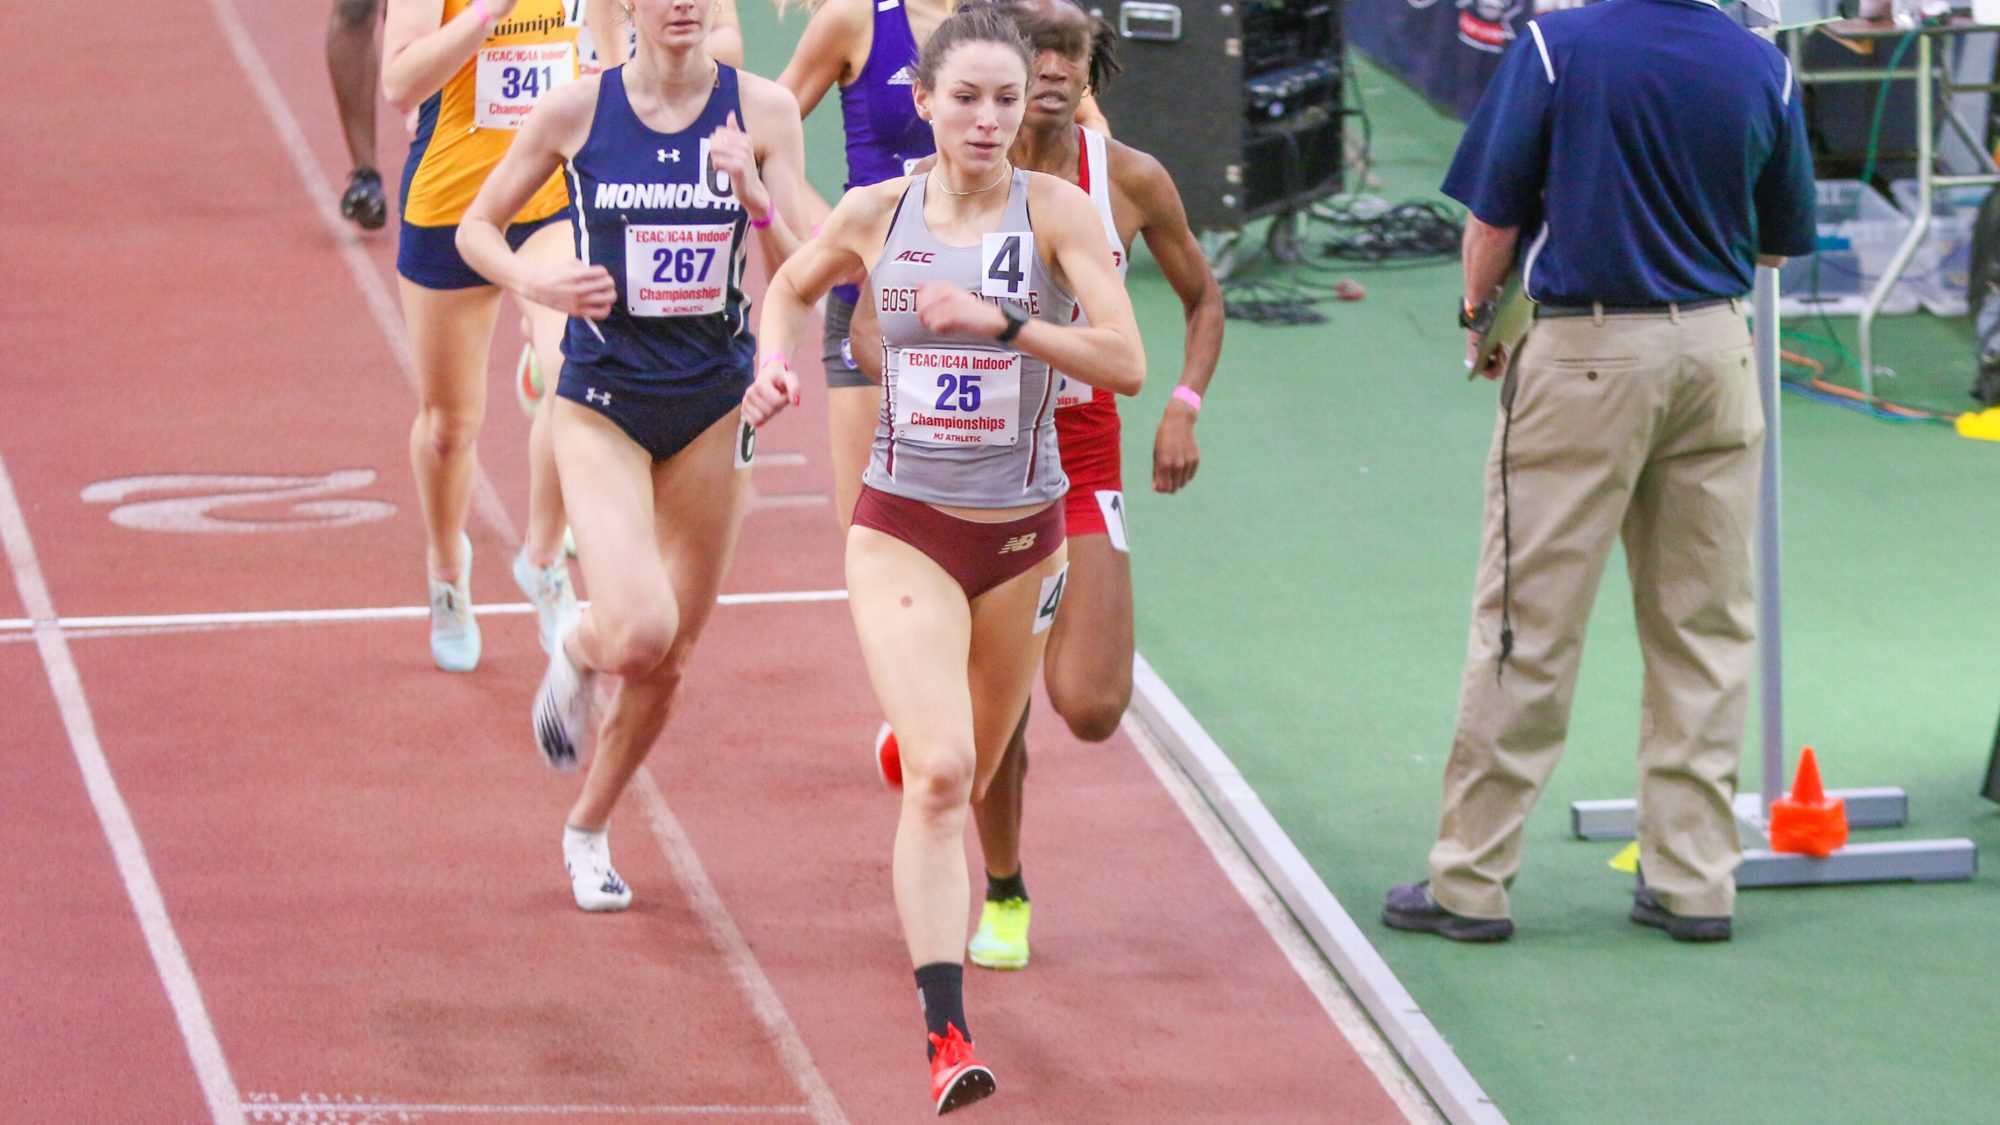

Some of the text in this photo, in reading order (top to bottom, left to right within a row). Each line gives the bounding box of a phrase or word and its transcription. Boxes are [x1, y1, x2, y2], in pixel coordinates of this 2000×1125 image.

[488, 9, 565, 41] uinnipi
[502, 65, 551, 99] 341
[636, 230, 730, 243] ECAC/IC4A Indoor
[653, 248, 716, 283] 267
[895, 250, 936, 264] ACC
[988, 235, 1025, 293] 4
[639, 287, 721, 302] Championships
[882, 288, 919, 312] BOST
[909, 353, 1012, 370] ECAC/IC4A Indoor
[935, 373, 982, 412] 25
[910, 412, 1005, 432] Championships
[945, 434, 981, 442] ATHLETIC
[1039, 571, 1065, 621] 4
